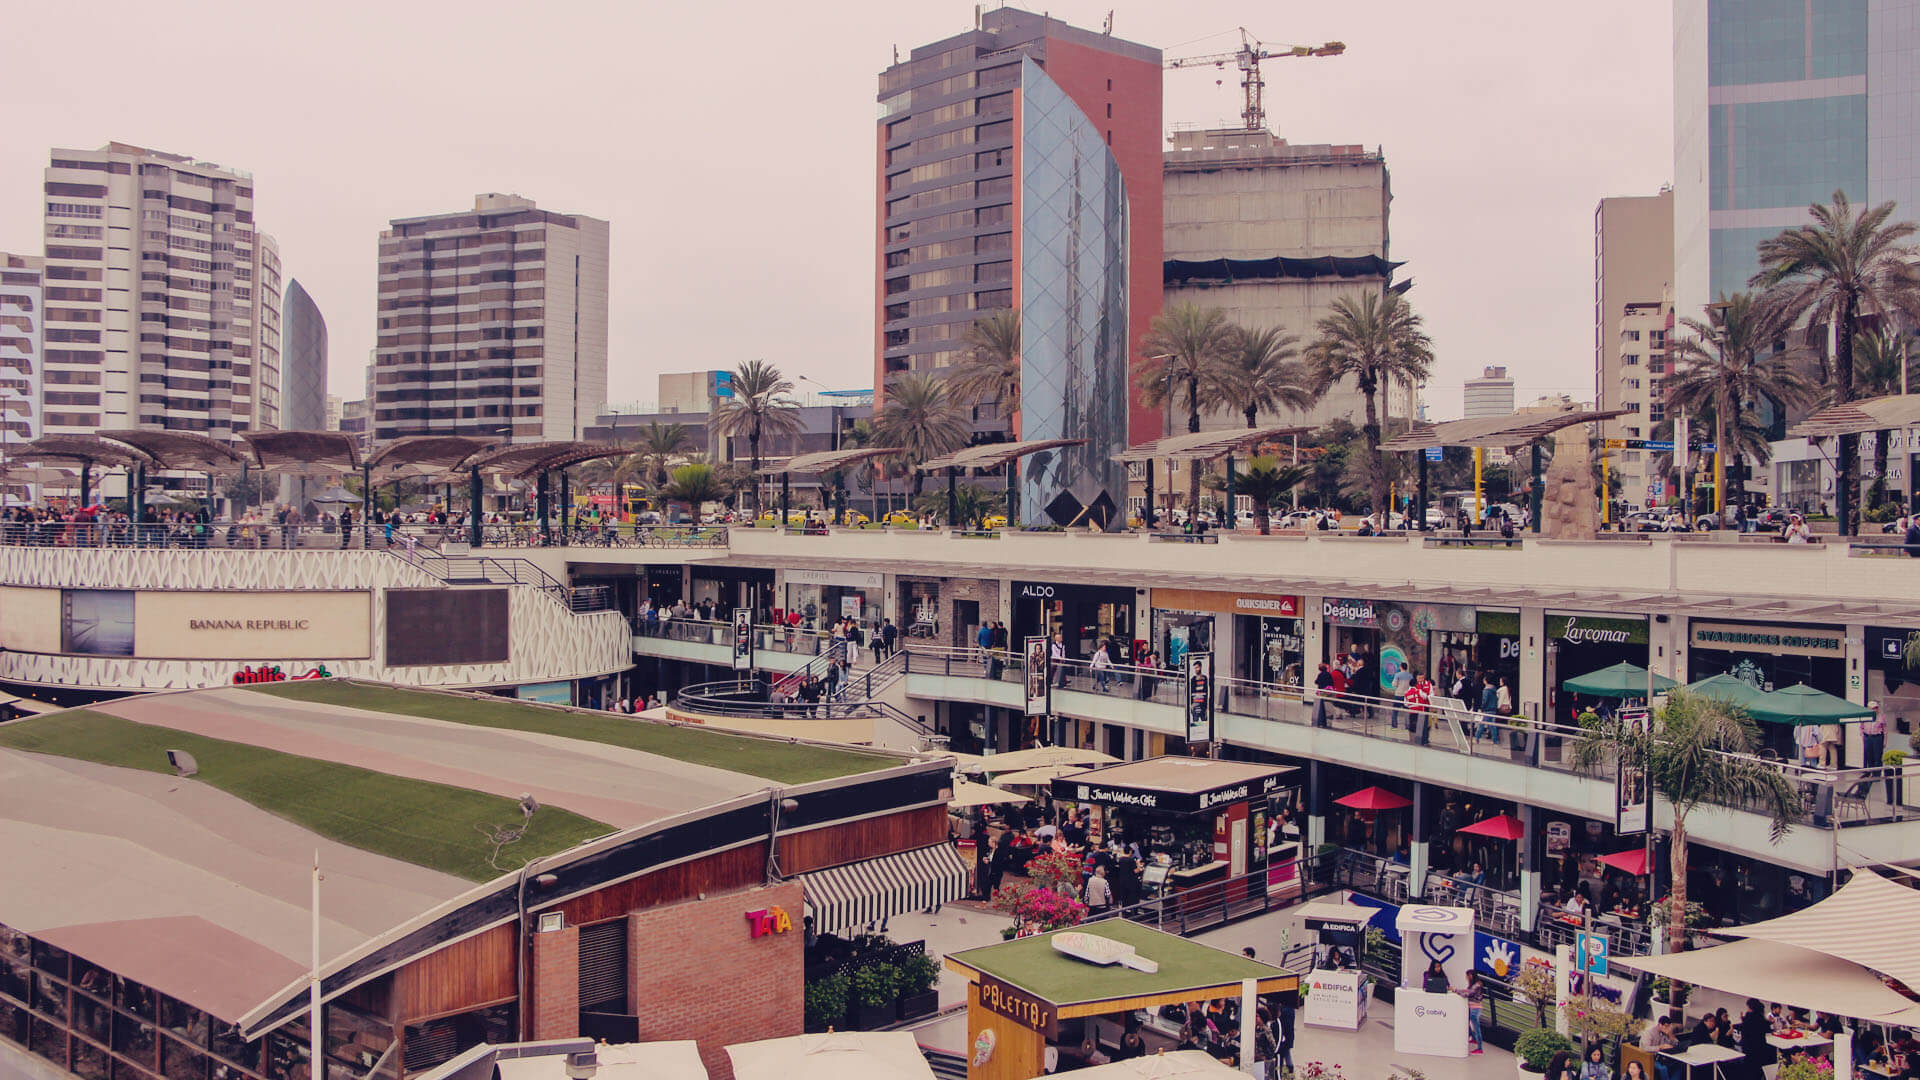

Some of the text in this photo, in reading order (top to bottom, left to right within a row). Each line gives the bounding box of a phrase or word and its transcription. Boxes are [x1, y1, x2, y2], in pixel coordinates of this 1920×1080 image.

[1022, 584, 1055, 598] ALDO
[1236, 598, 1281, 611] QUIKSILVER
[189, 619, 310, 631] BANANA REPUBLIC
[1563, 616, 1631, 645] Larcomar
[1696, 630, 1780, 647] STARBUCKS
[1781, 635, 1840, 651] COFFEE
[1090, 788, 1112, 801] Juan
[1329, 923, 1356, 933] EDIFICA
[1322, 983, 1354, 993] EDIFICA
[983, 984, 1049, 1031] PALETTAS
